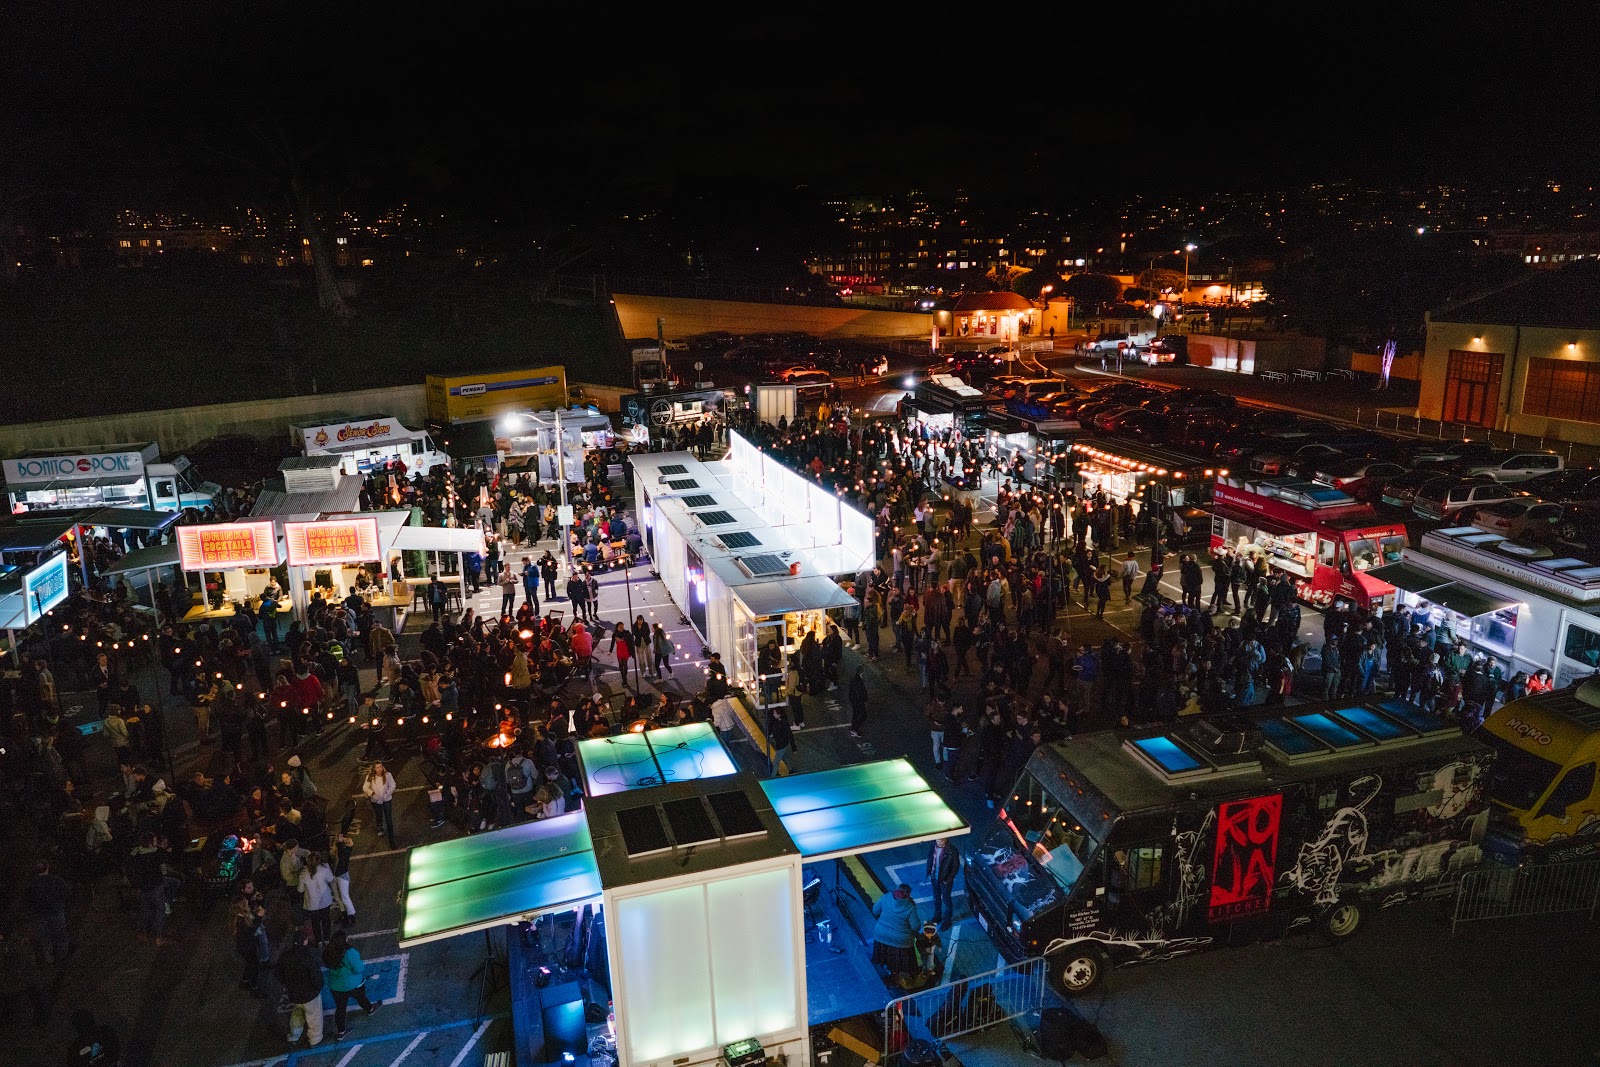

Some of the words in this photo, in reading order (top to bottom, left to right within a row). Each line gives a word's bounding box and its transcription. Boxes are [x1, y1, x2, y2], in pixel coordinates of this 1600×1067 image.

[461, 386, 485, 394] PENSKE
[17, 459, 75, 477] BONITO
[91, 456, 130, 473] POKE
[202, 530, 251, 542] DRINKS
[308, 526, 355, 538] DRINKS
[203, 540, 252, 552] COCKTAILS
[309, 536, 356, 548] COCKTAILS
[205, 550, 254, 562] BEER
[310, 546, 358, 558] BEER
[1429, 541, 1463, 557] HANDCRAFTED
[1463, 552, 1495, 568] DOUGHNUTS
[1517, 571, 1534, 583] COFFEE
[1538, 578, 1563, 593] ESPRESSO
[1563, 586, 1575, 597] BAR
[1587, 591, 1600, 599] DO
[1505, 719, 1551, 746] MOMO
[1208, 899, 1270, 918] KITCHEN
